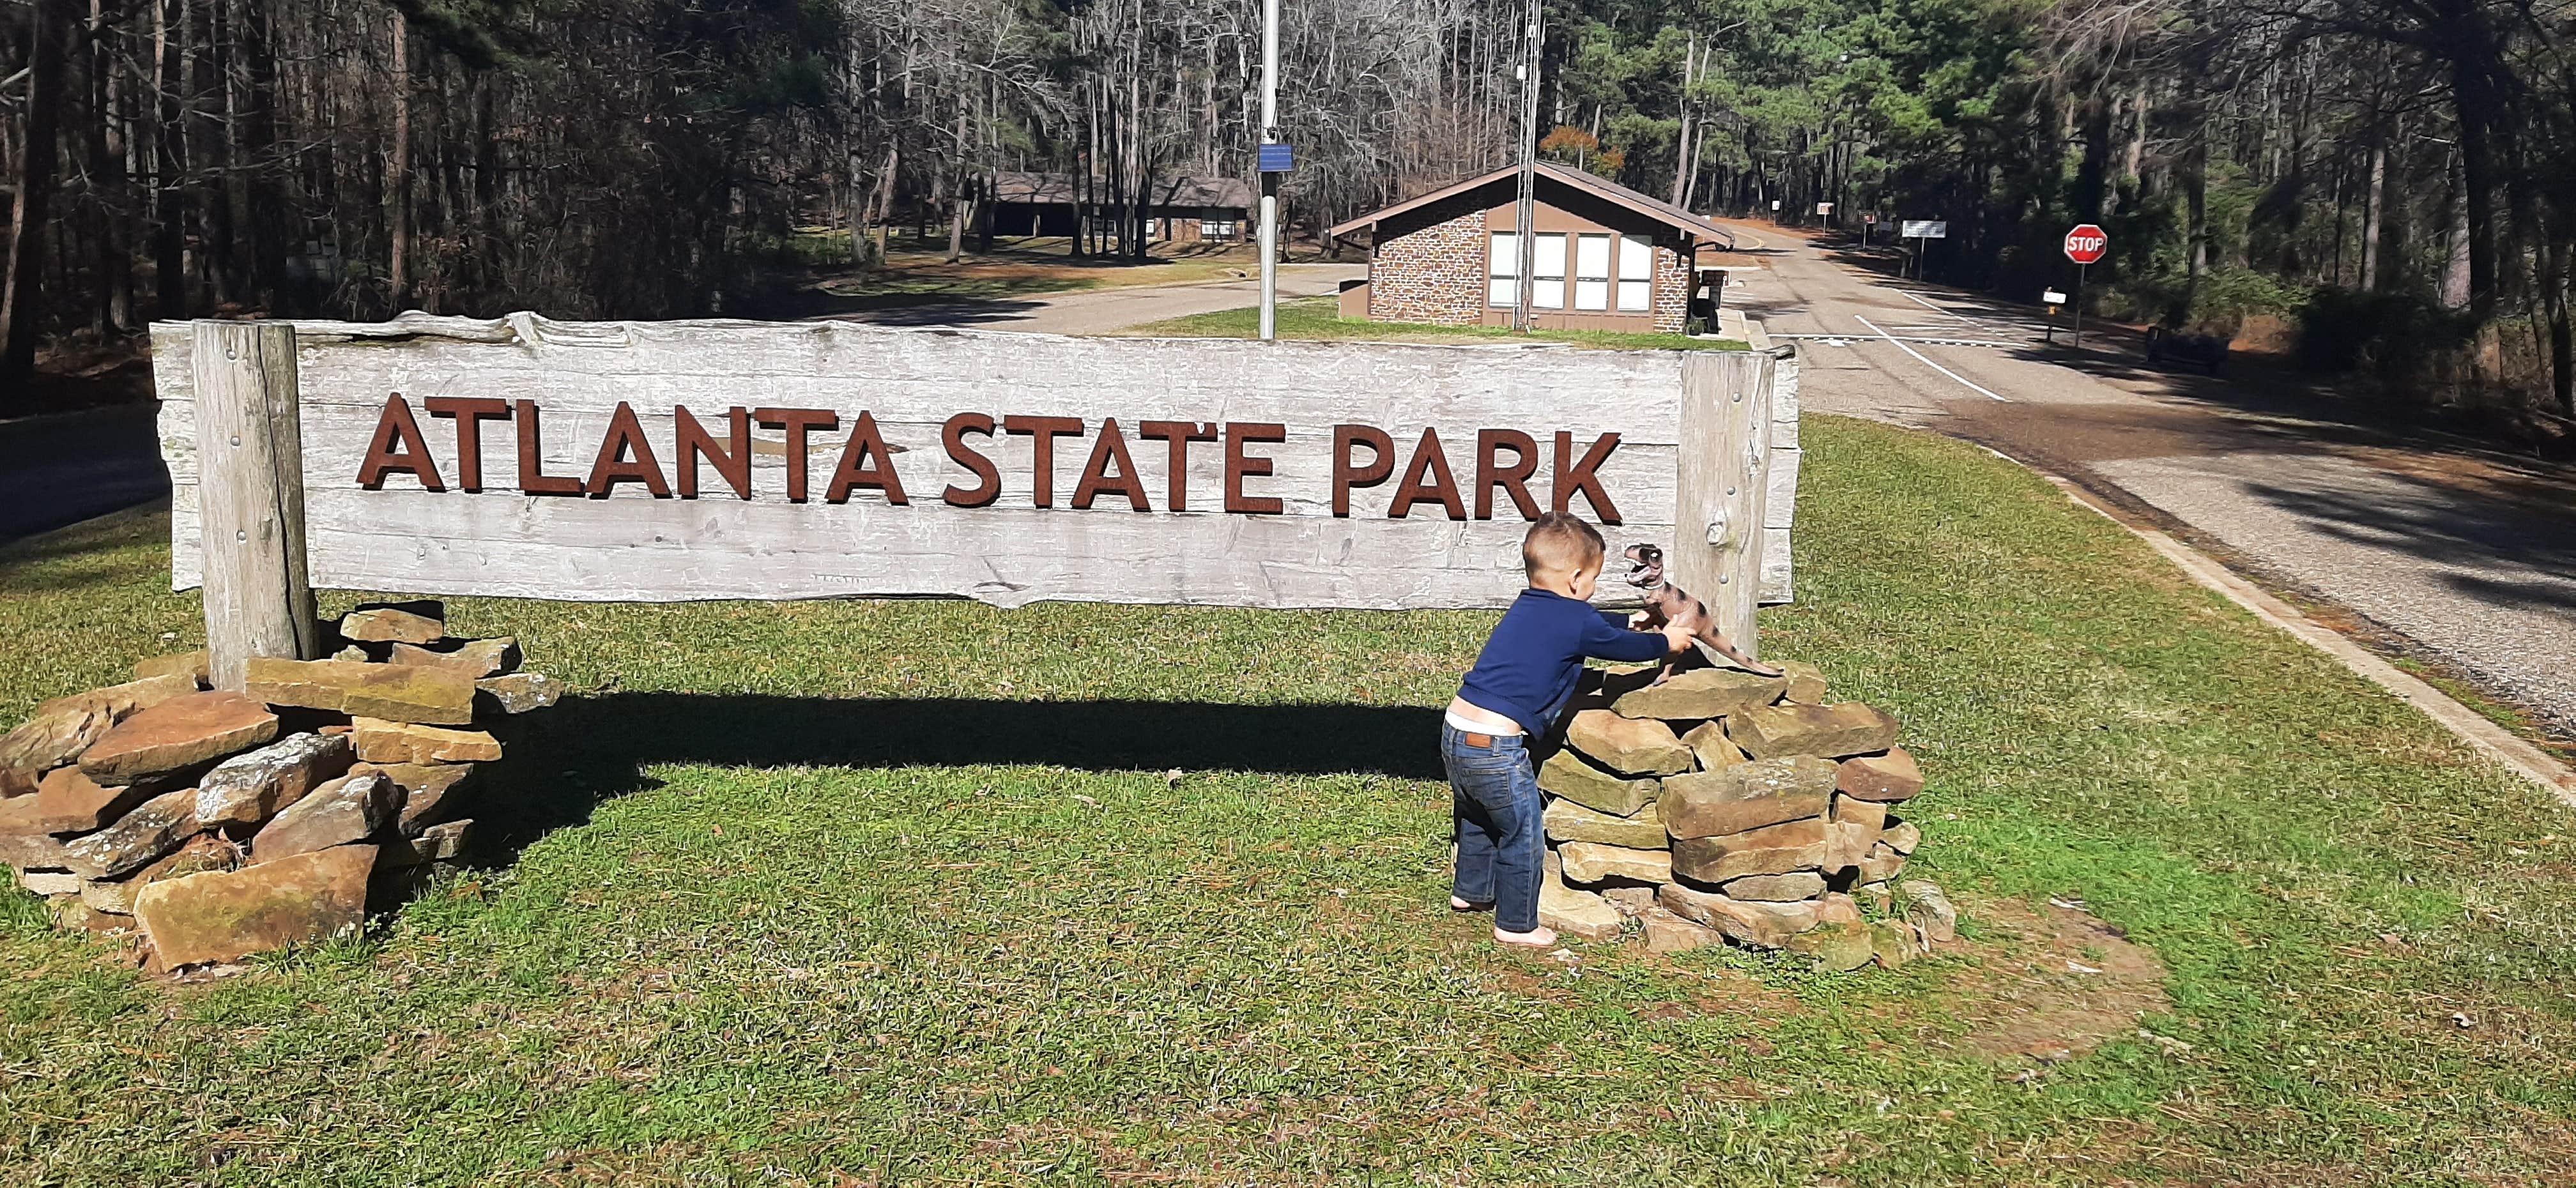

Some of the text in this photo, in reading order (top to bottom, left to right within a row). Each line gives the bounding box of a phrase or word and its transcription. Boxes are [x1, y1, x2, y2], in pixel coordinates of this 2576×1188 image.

[2069, 237, 2103, 251] STOP
[355, 392, 1623, 526] ATLANTA STATE PARK
